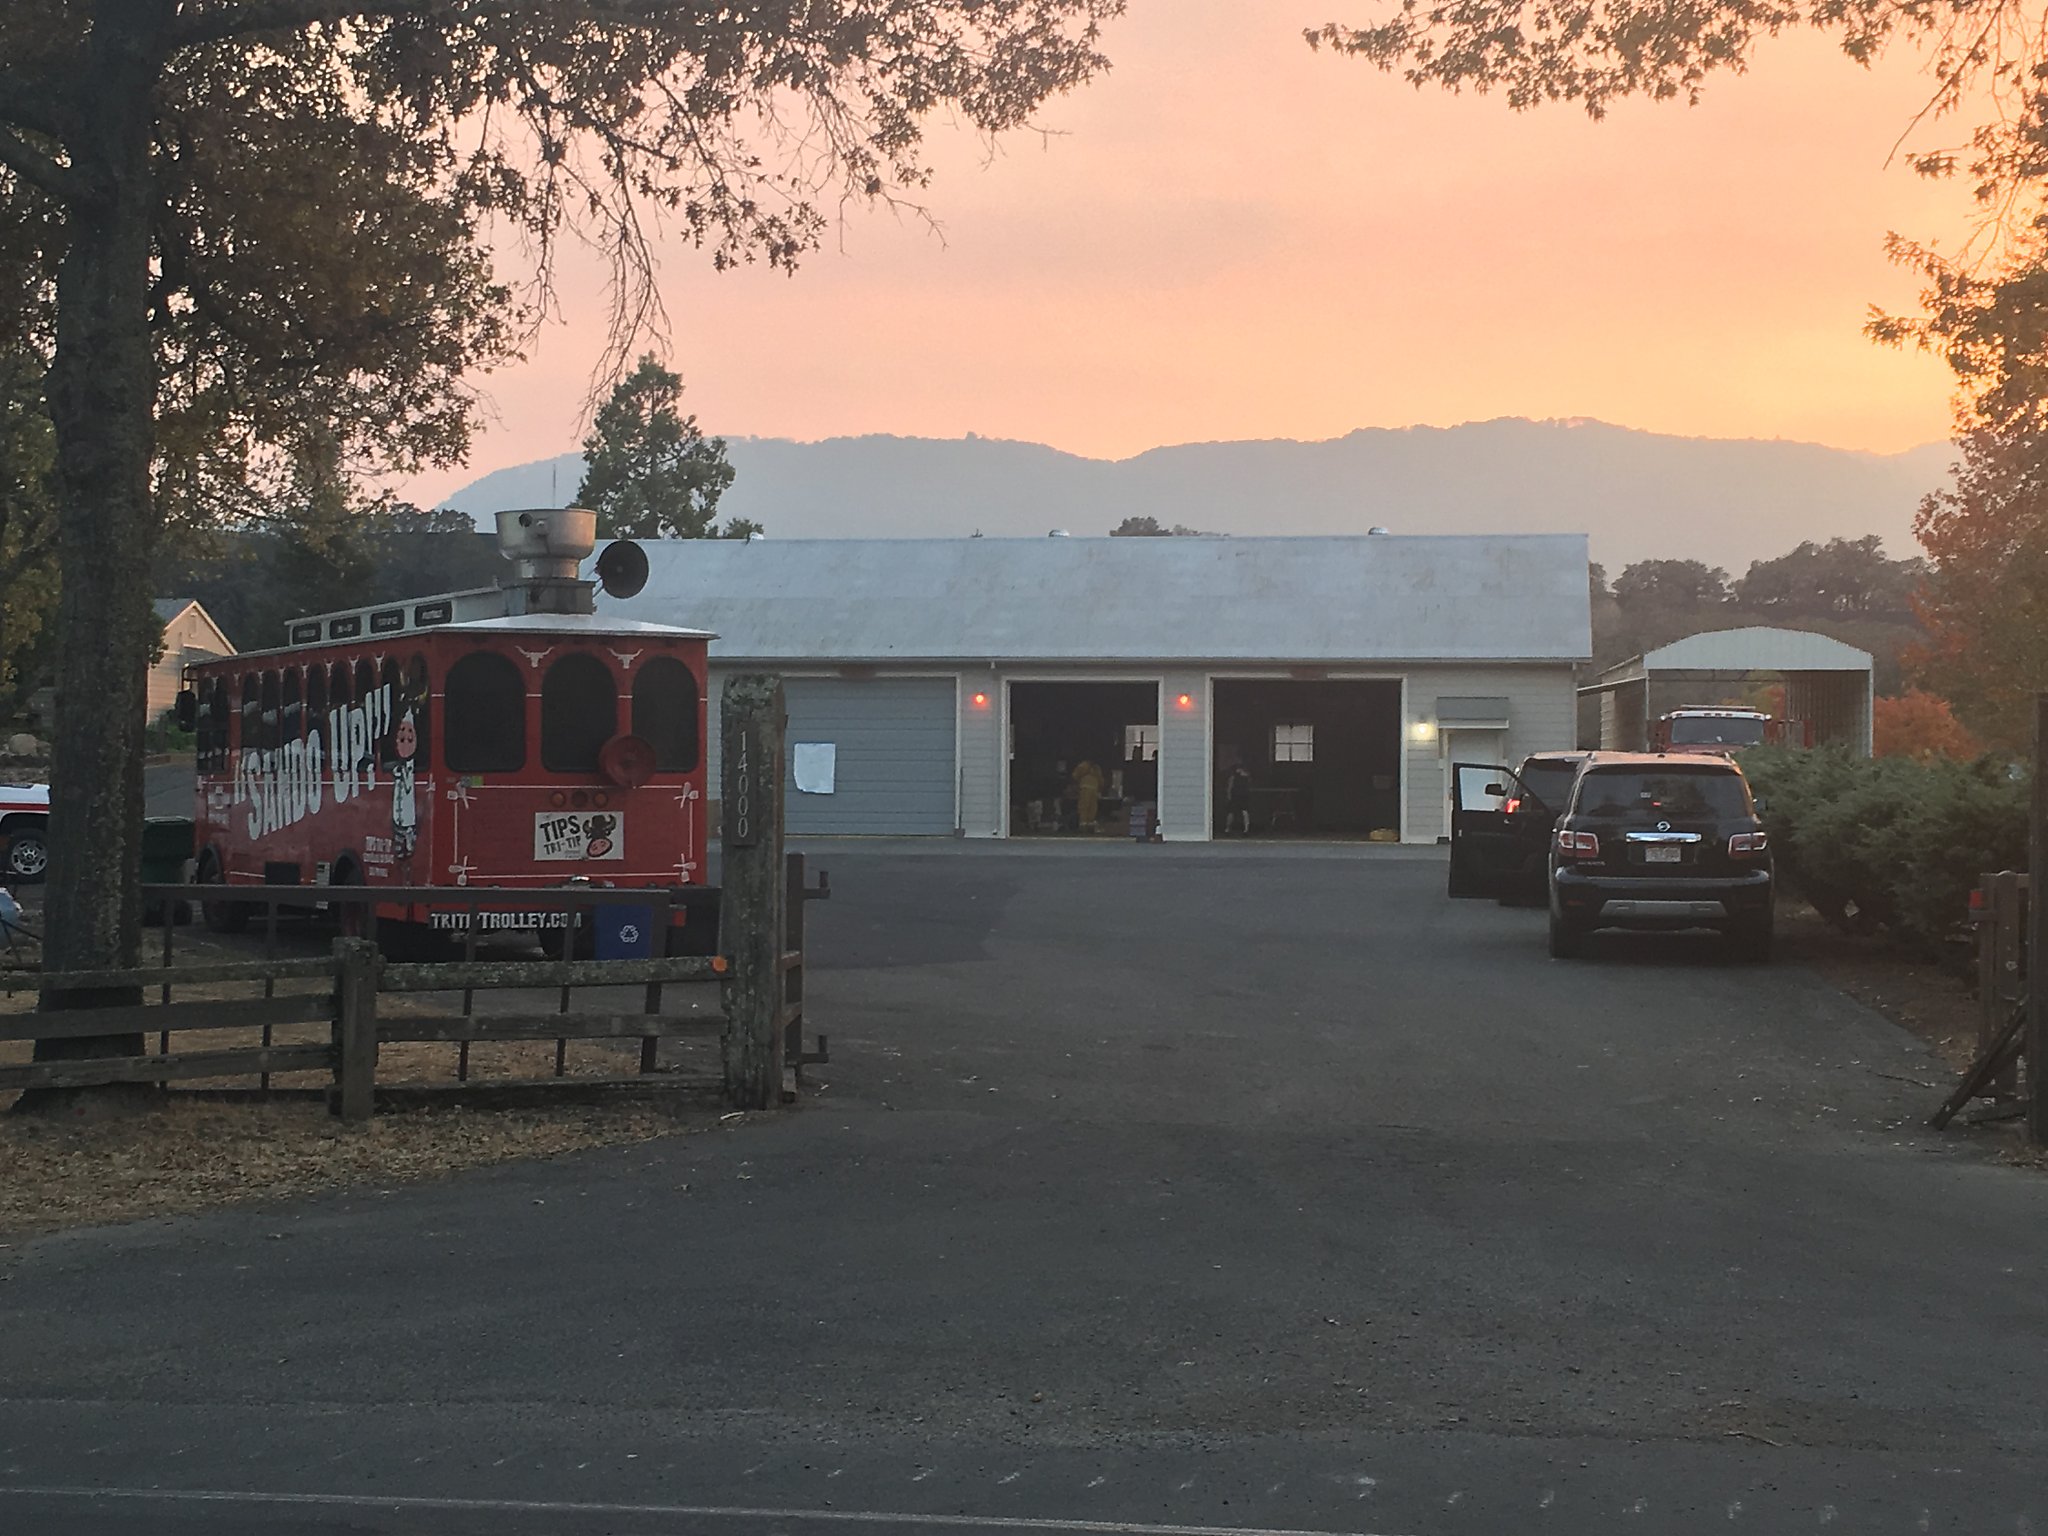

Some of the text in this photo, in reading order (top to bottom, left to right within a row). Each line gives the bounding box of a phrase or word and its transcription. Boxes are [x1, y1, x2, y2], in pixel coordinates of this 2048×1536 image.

[738, 730, 749, 838] 14000
[539, 815, 581, 842] TIPS
[544, 835, 581, 855] TRI-TIP
